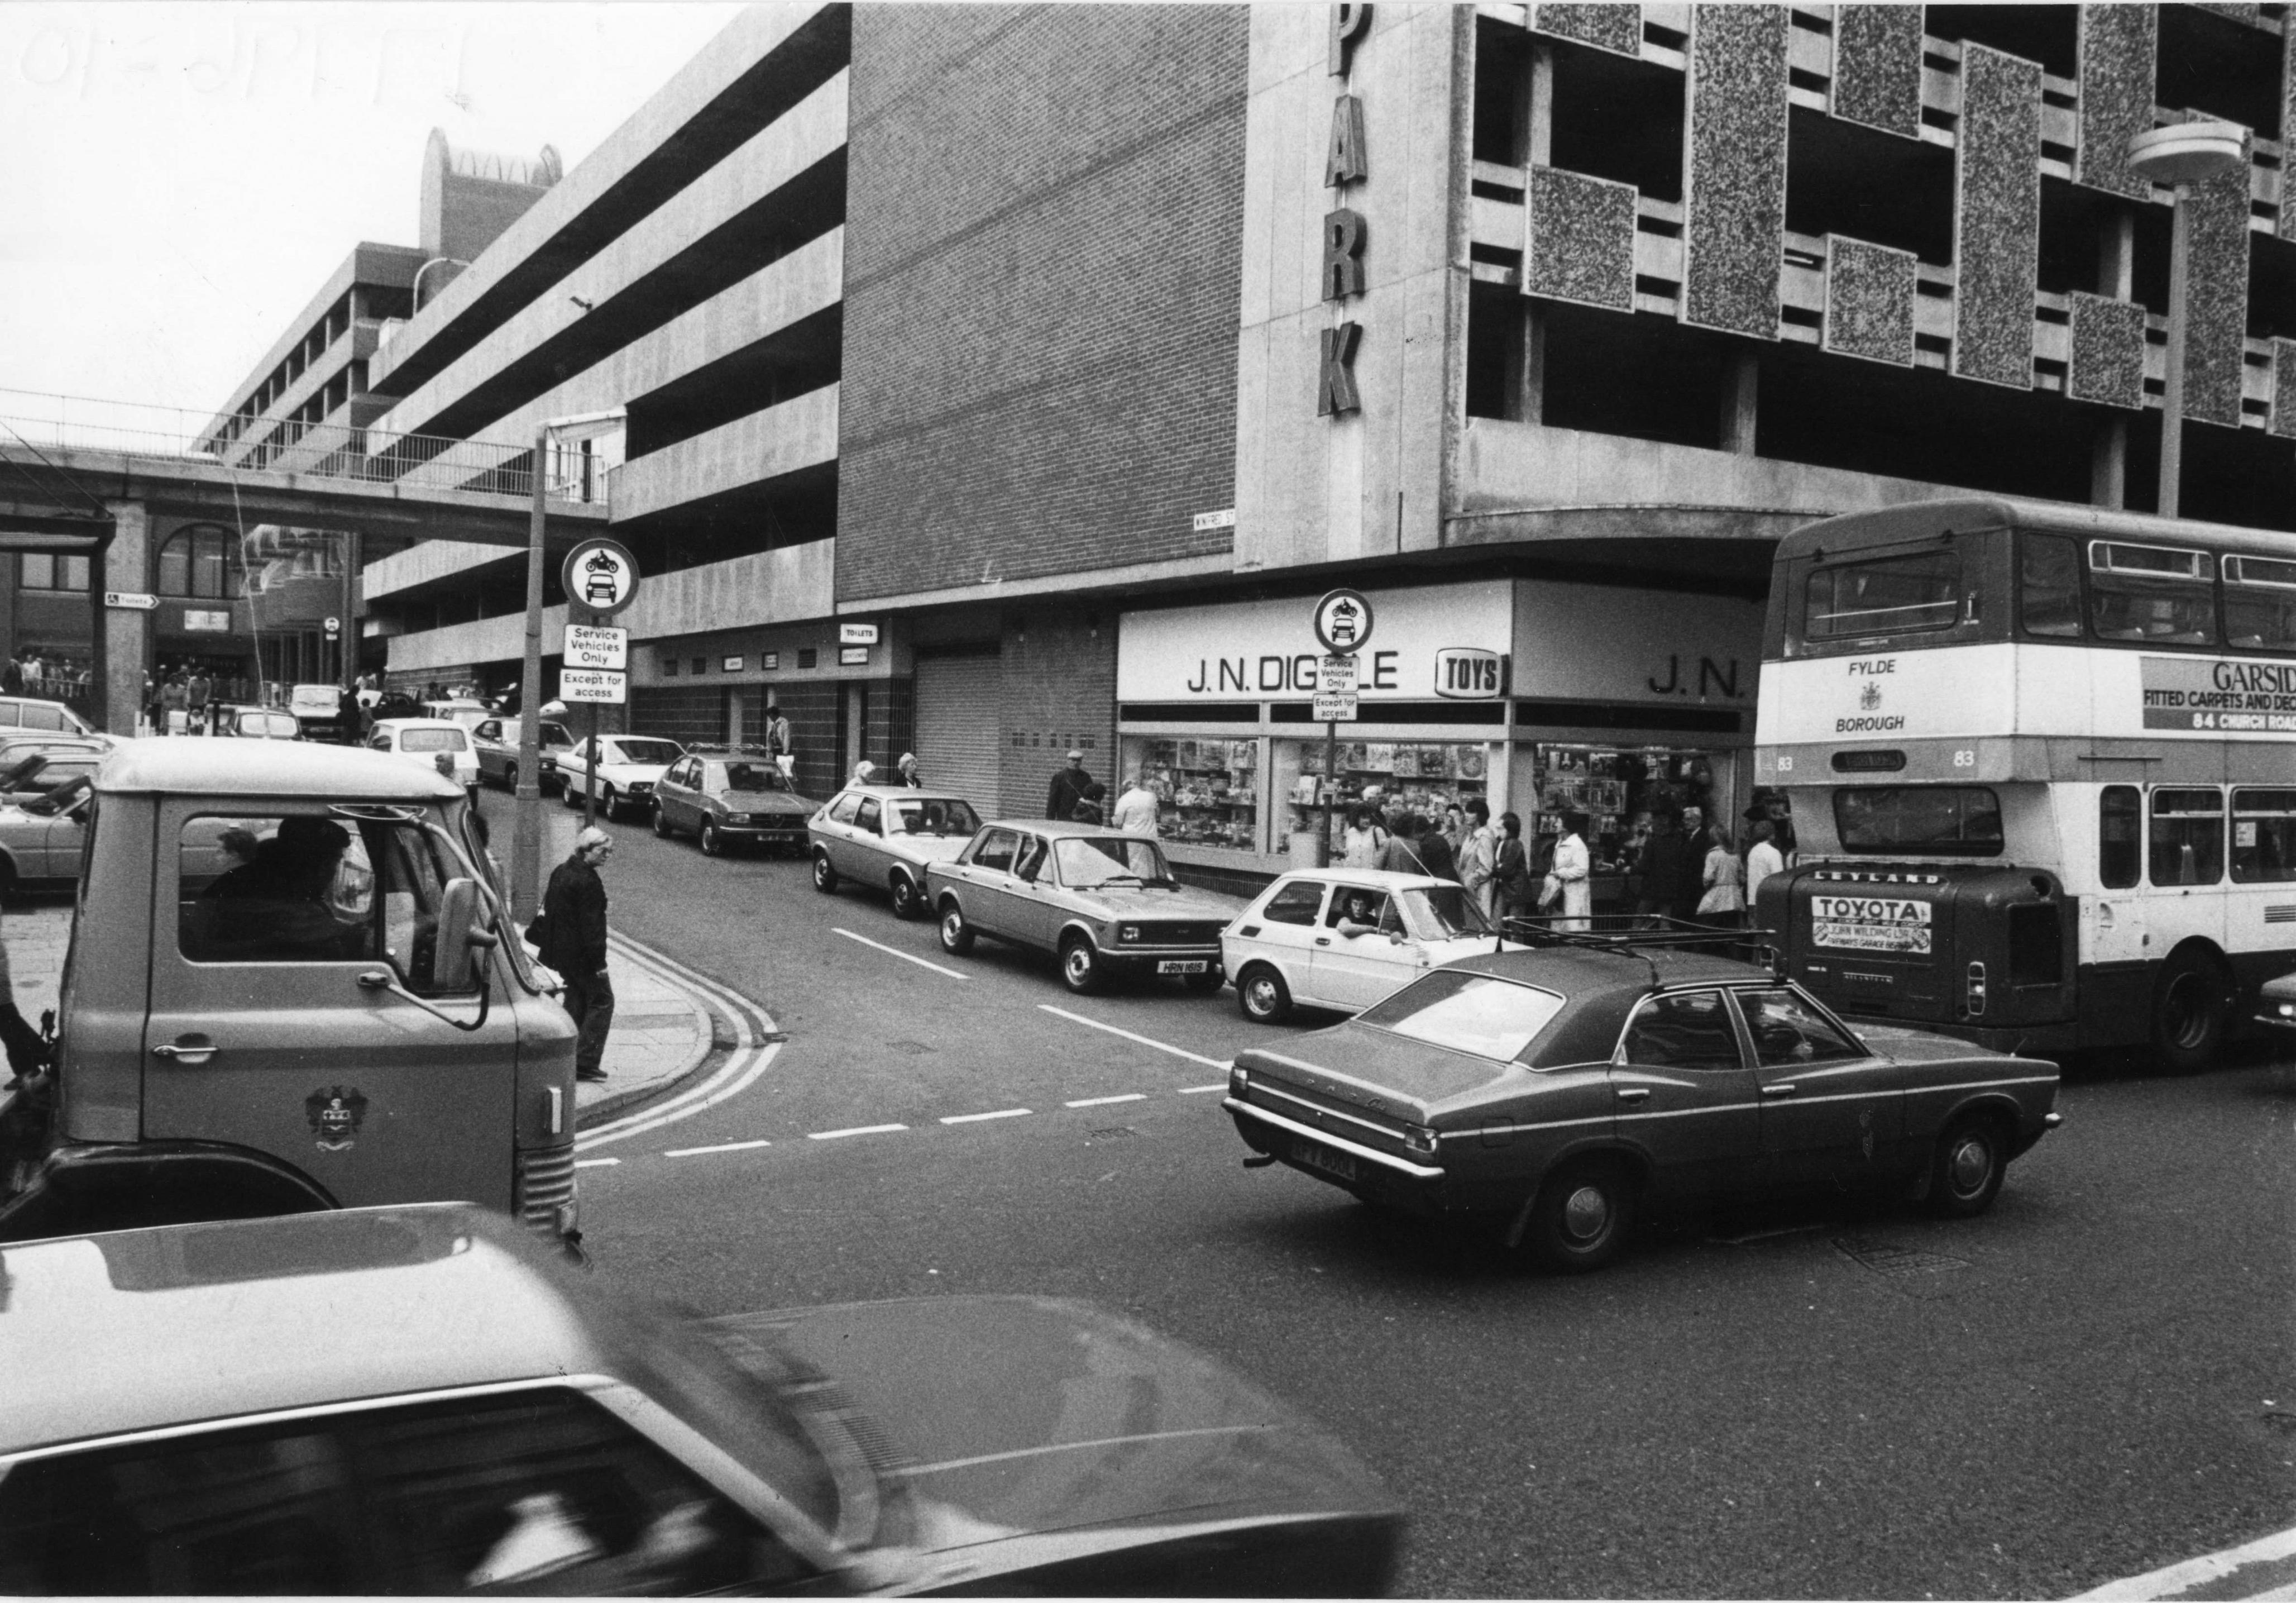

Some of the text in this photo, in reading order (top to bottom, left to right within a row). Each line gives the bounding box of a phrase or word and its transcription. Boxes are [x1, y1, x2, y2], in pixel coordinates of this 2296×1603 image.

[1318, 3, 1373, 420] PARK
[575, 628, 619, 640] Service
[846, 629, 873, 637] TOILETS
[571, 640, 620, 652] Vehicles
[581, 652, 608, 665] Only
[1323, 659, 1353, 668] Service
[1260, 651, 1399, 691] DIGE
[1848, 659, 1896, 676] FYLDE
[565, 674, 622, 685] Except for
[1446, 658, 1497, 691] TOYS
[1327, 679, 1346, 689] Only
[575, 689, 613, 698] access
[2144, 689, 2185, 707] FITTED
[2188, 691, 2243, 709] CARPETS
[2245, 694, 2272, 709] AND
[1315, 698, 1342, 707] Except
[1835, 715, 1905, 732] BOROUGH
[2193, 713, 2214, 729] 84
[2219, 714, 2266, 729] CHURCH
[1777, 756, 1793, 771] 83
[1954, 750, 1974, 767] 83
[1814, 871, 1939, 884] LEYLAND
[1819, 899, 1920, 920] TOYOTA
[1831, 925, 1852, 936] JOHN
[1854, 927, 1892, 938] WILDING
[1859, 939, 1885, 949] GARAGE
[1164, 962, 1203, 972] HRN 161S
